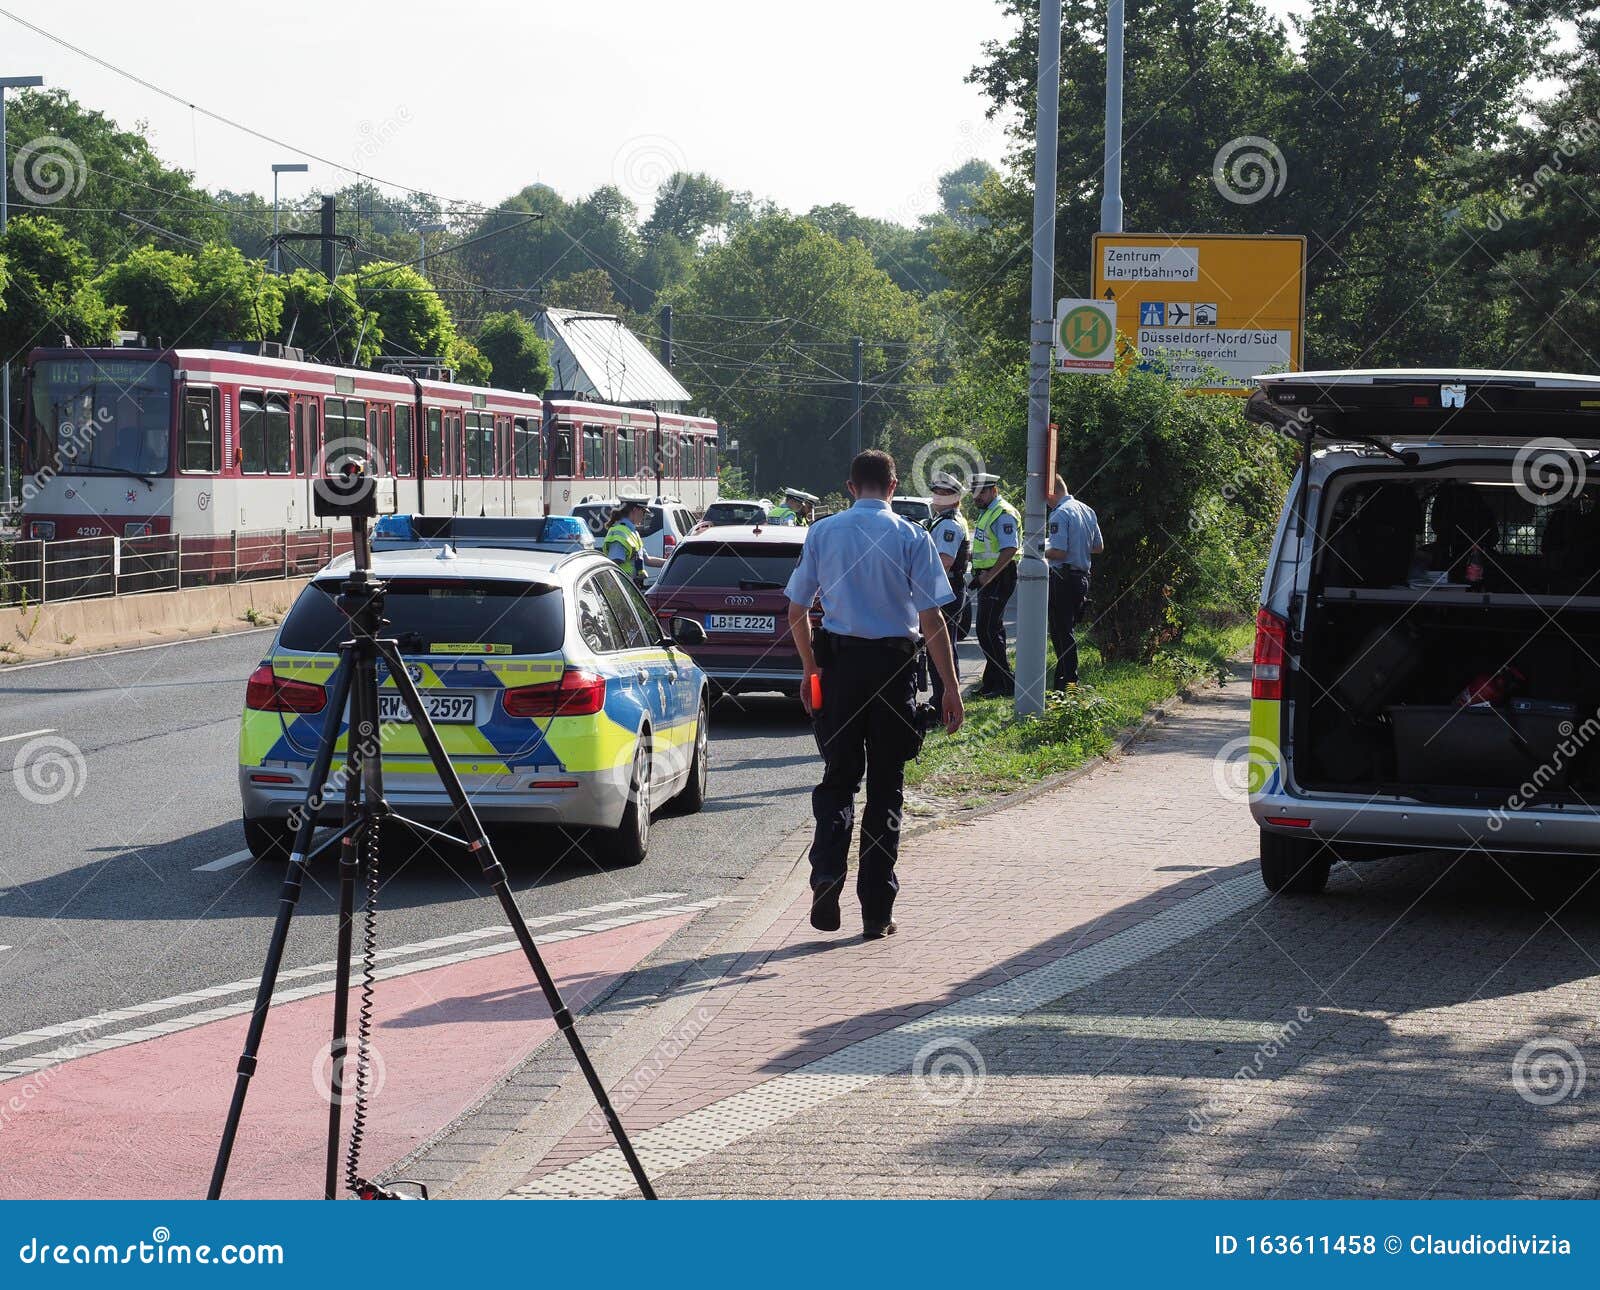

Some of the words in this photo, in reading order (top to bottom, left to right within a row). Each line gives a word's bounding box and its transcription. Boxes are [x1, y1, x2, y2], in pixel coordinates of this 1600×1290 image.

[1108, 250, 1161, 262] Zentrum
[1141, 331, 1277, 345] Düsseldorf-Nord/Süd
[77, 527, 102, 537] 4207
[711, 616, 727, 628] LB
[734, 616, 742, 629] E
[744, 617, 773, 630] 2224
